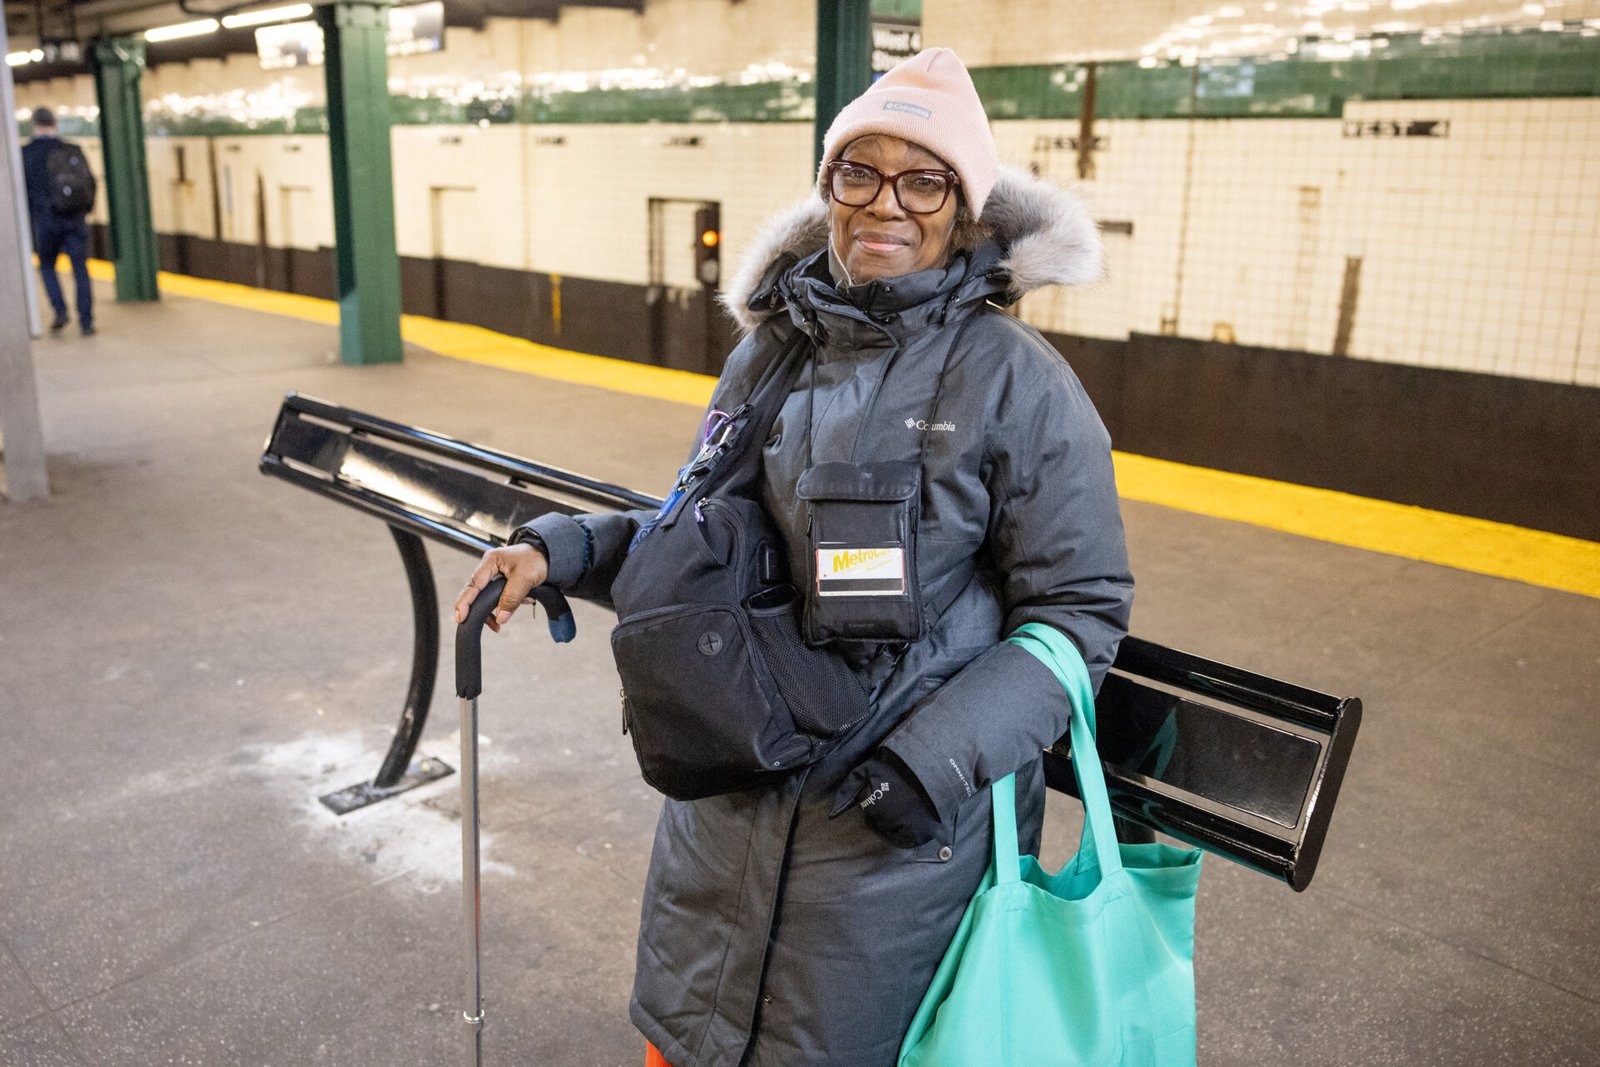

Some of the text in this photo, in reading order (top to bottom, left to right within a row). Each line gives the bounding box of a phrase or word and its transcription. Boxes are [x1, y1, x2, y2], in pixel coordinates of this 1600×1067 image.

[916, 419, 956, 431] Coumbia
[833, 548, 893, 573] MetroC
[949, 758, 972, 798] OMNI-TEC
[860, 789, 884, 811] Colum
